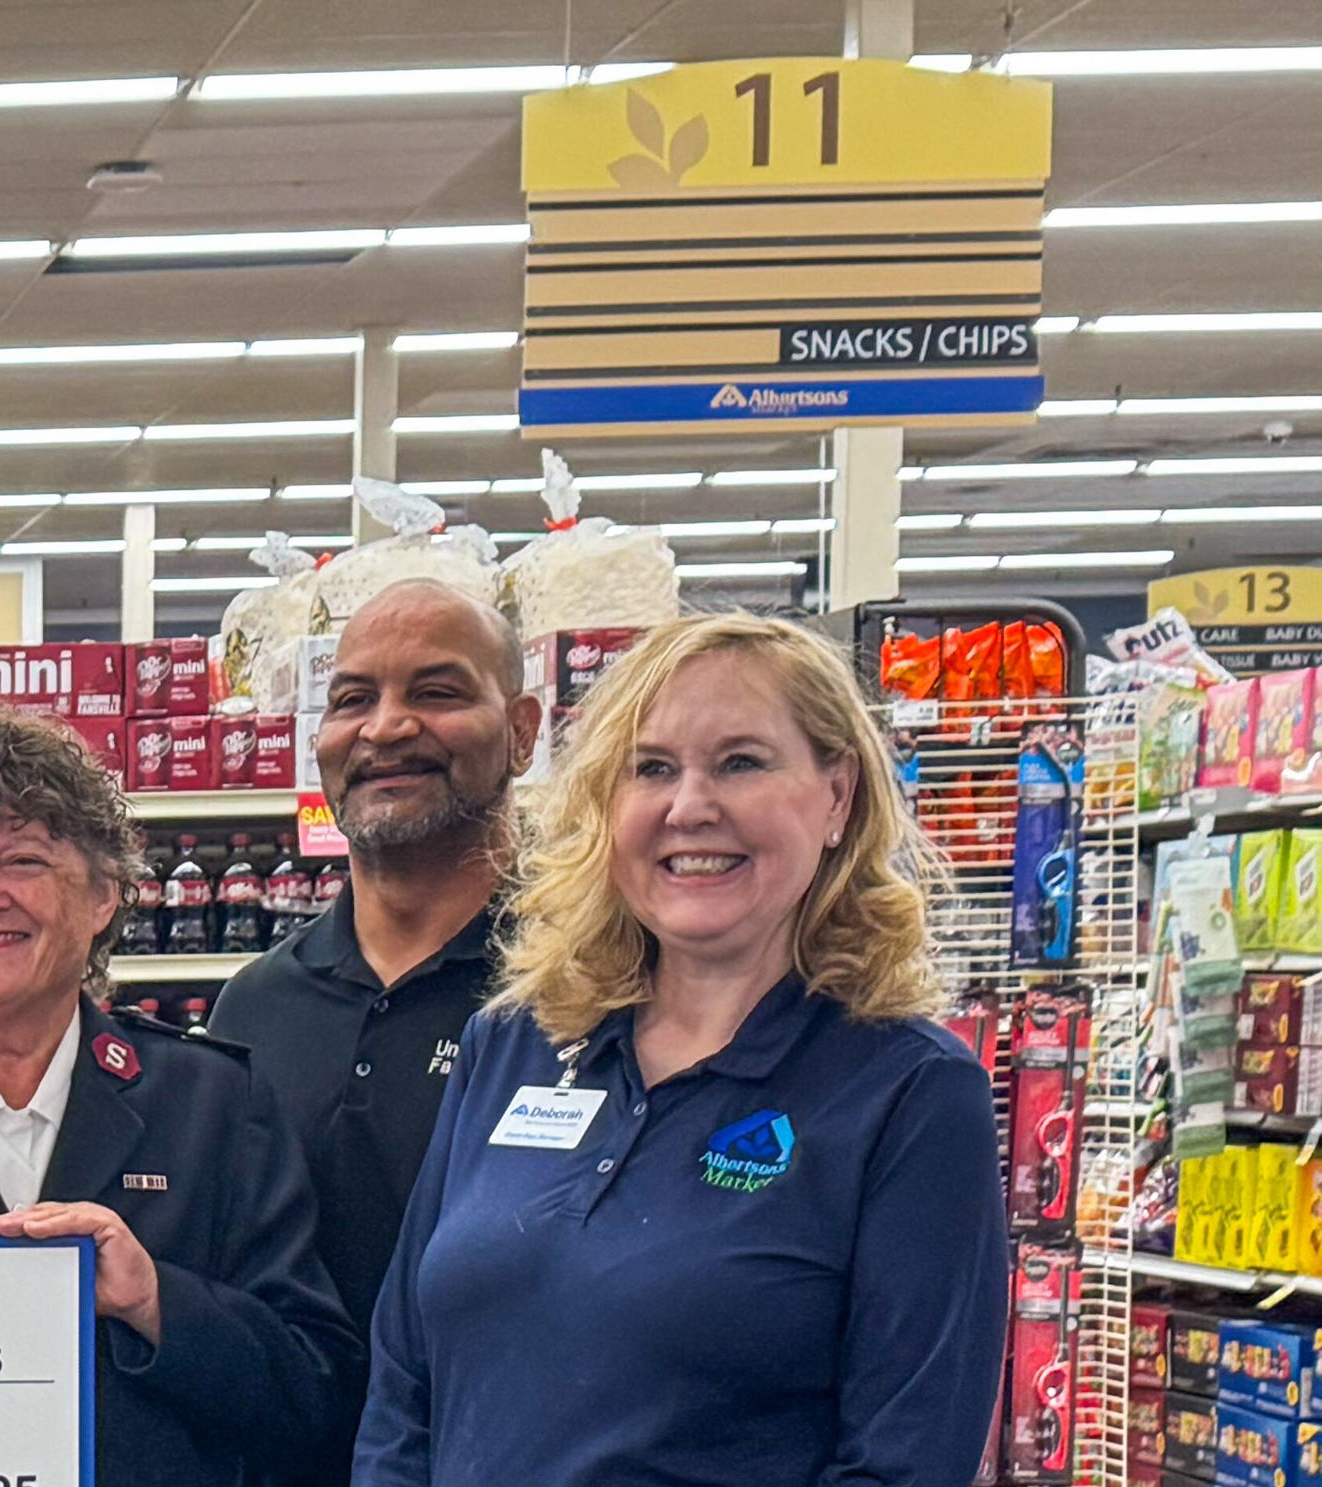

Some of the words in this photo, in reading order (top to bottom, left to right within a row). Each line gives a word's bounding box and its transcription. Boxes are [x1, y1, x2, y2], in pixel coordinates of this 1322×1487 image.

[735, 72, 840, 168] 11
[1239, 571, 1292, 613] 13
[1265, 627, 1303, 641] BABY
[173, 659, 206, 675] mini
[1271, 653, 1309, 667] BABY
[173, 736, 206, 752] mini
[258, 733, 290, 749] mini
[105, 1042, 127, 1069] S
[530, 1107, 584, 1120] Deborah
